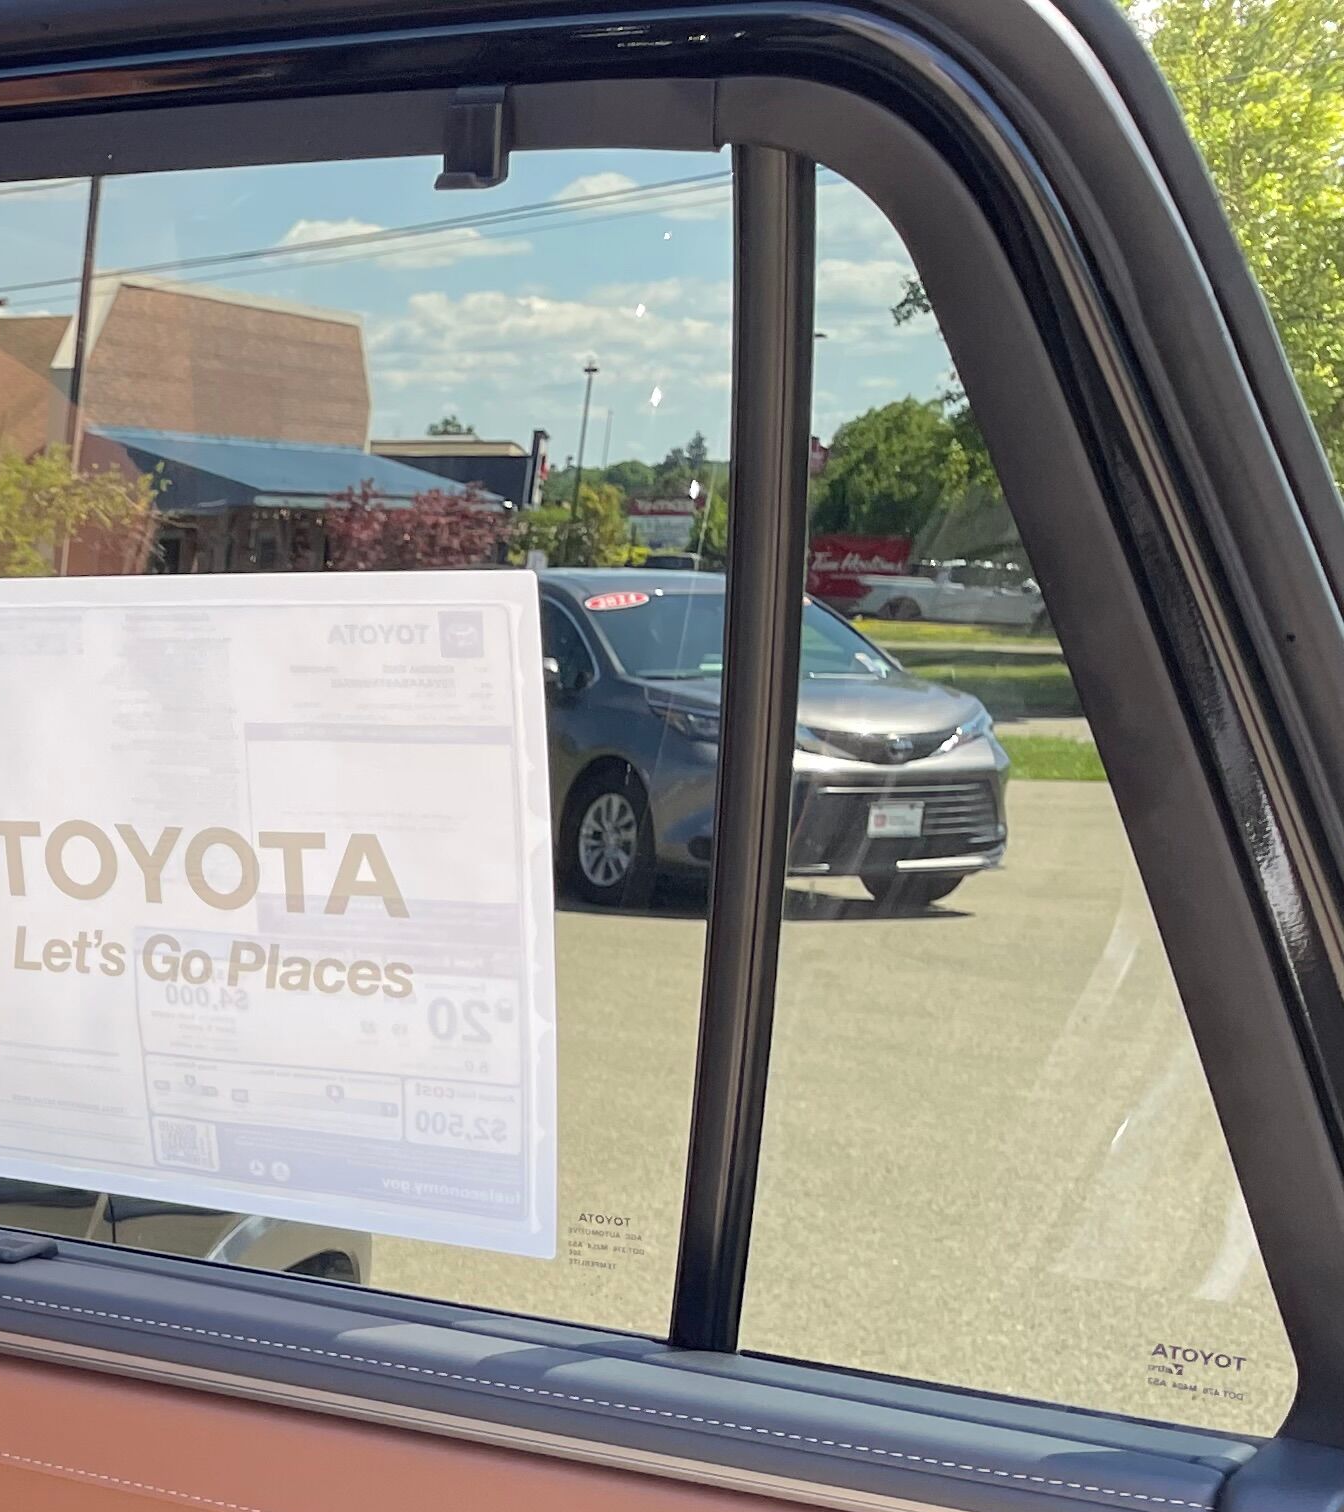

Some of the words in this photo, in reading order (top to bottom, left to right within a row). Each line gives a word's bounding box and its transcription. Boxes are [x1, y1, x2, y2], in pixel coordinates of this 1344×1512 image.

[14, 925, 126, 976] Let's
[142, 933, 213, 985] Go
[227, 939, 414, 998] Places
